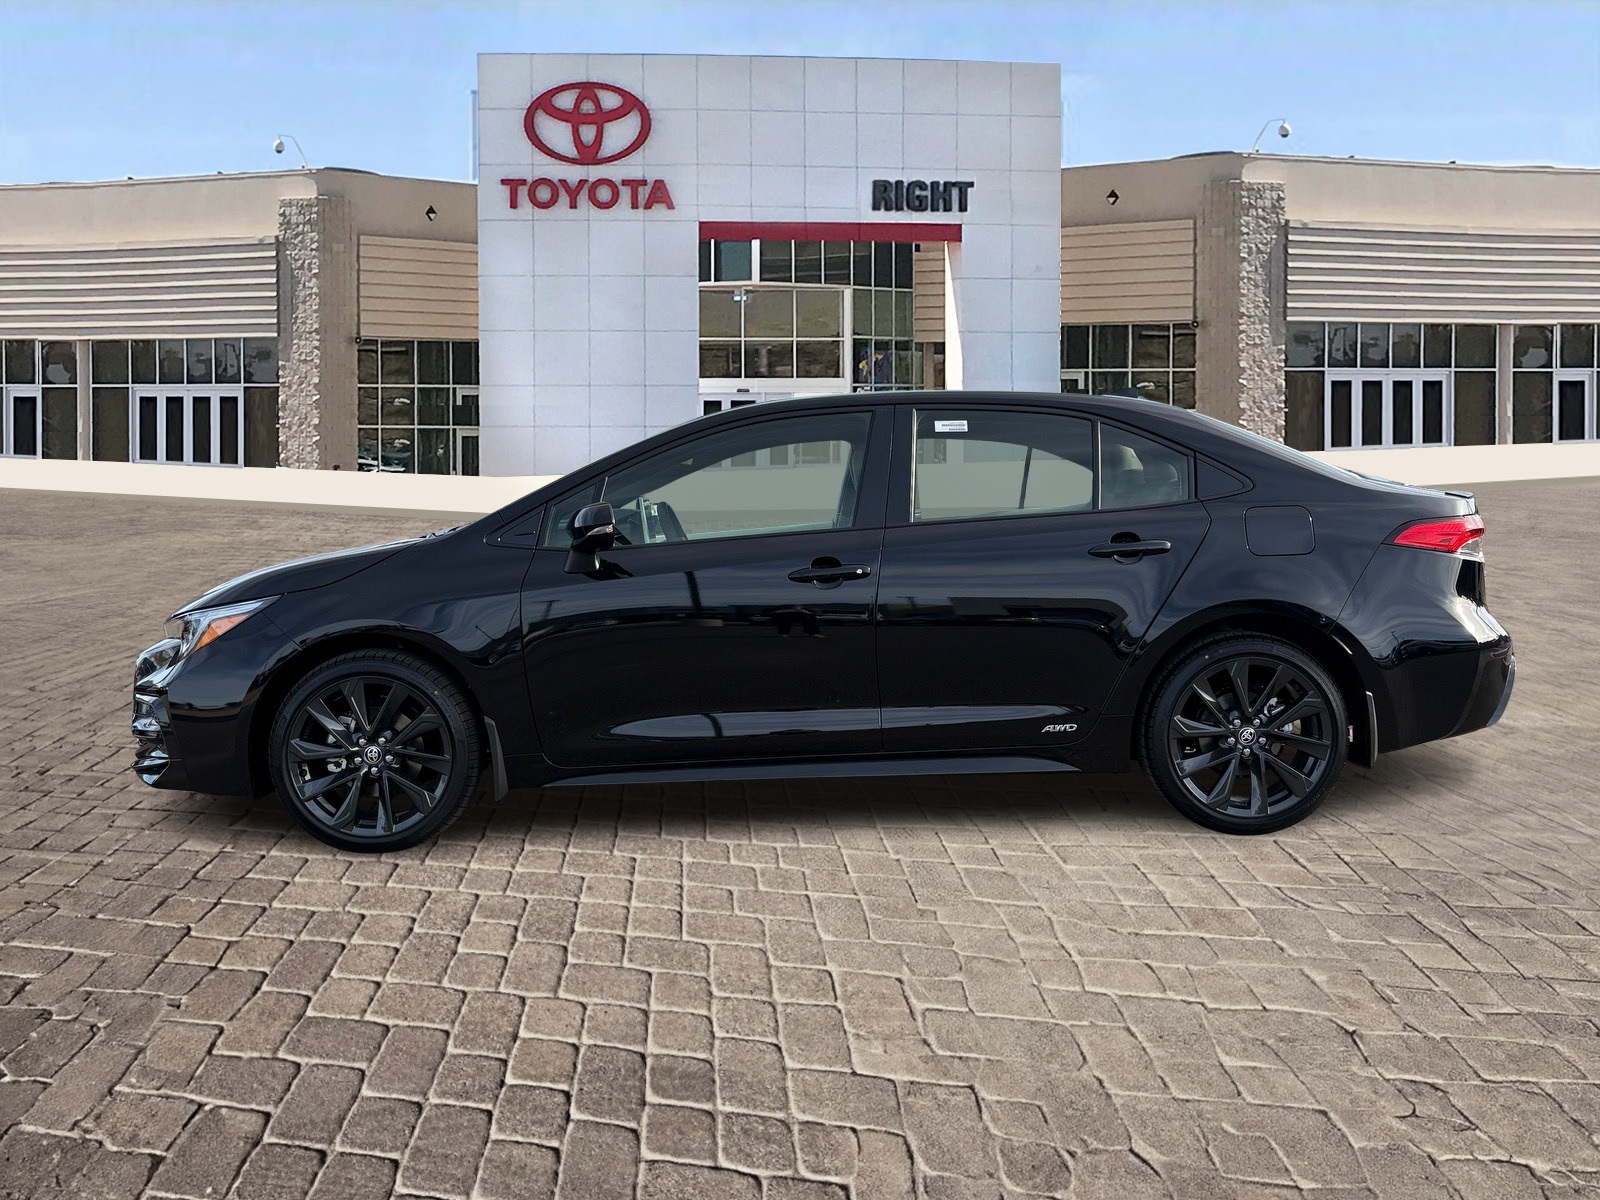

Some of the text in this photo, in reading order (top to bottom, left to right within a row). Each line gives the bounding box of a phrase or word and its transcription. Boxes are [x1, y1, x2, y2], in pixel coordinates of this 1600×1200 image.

[500, 178, 675, 209] TOYOTA
[872, 180, 974, 212] RIGHT
[1041, 723, 1077, 733] AWD
